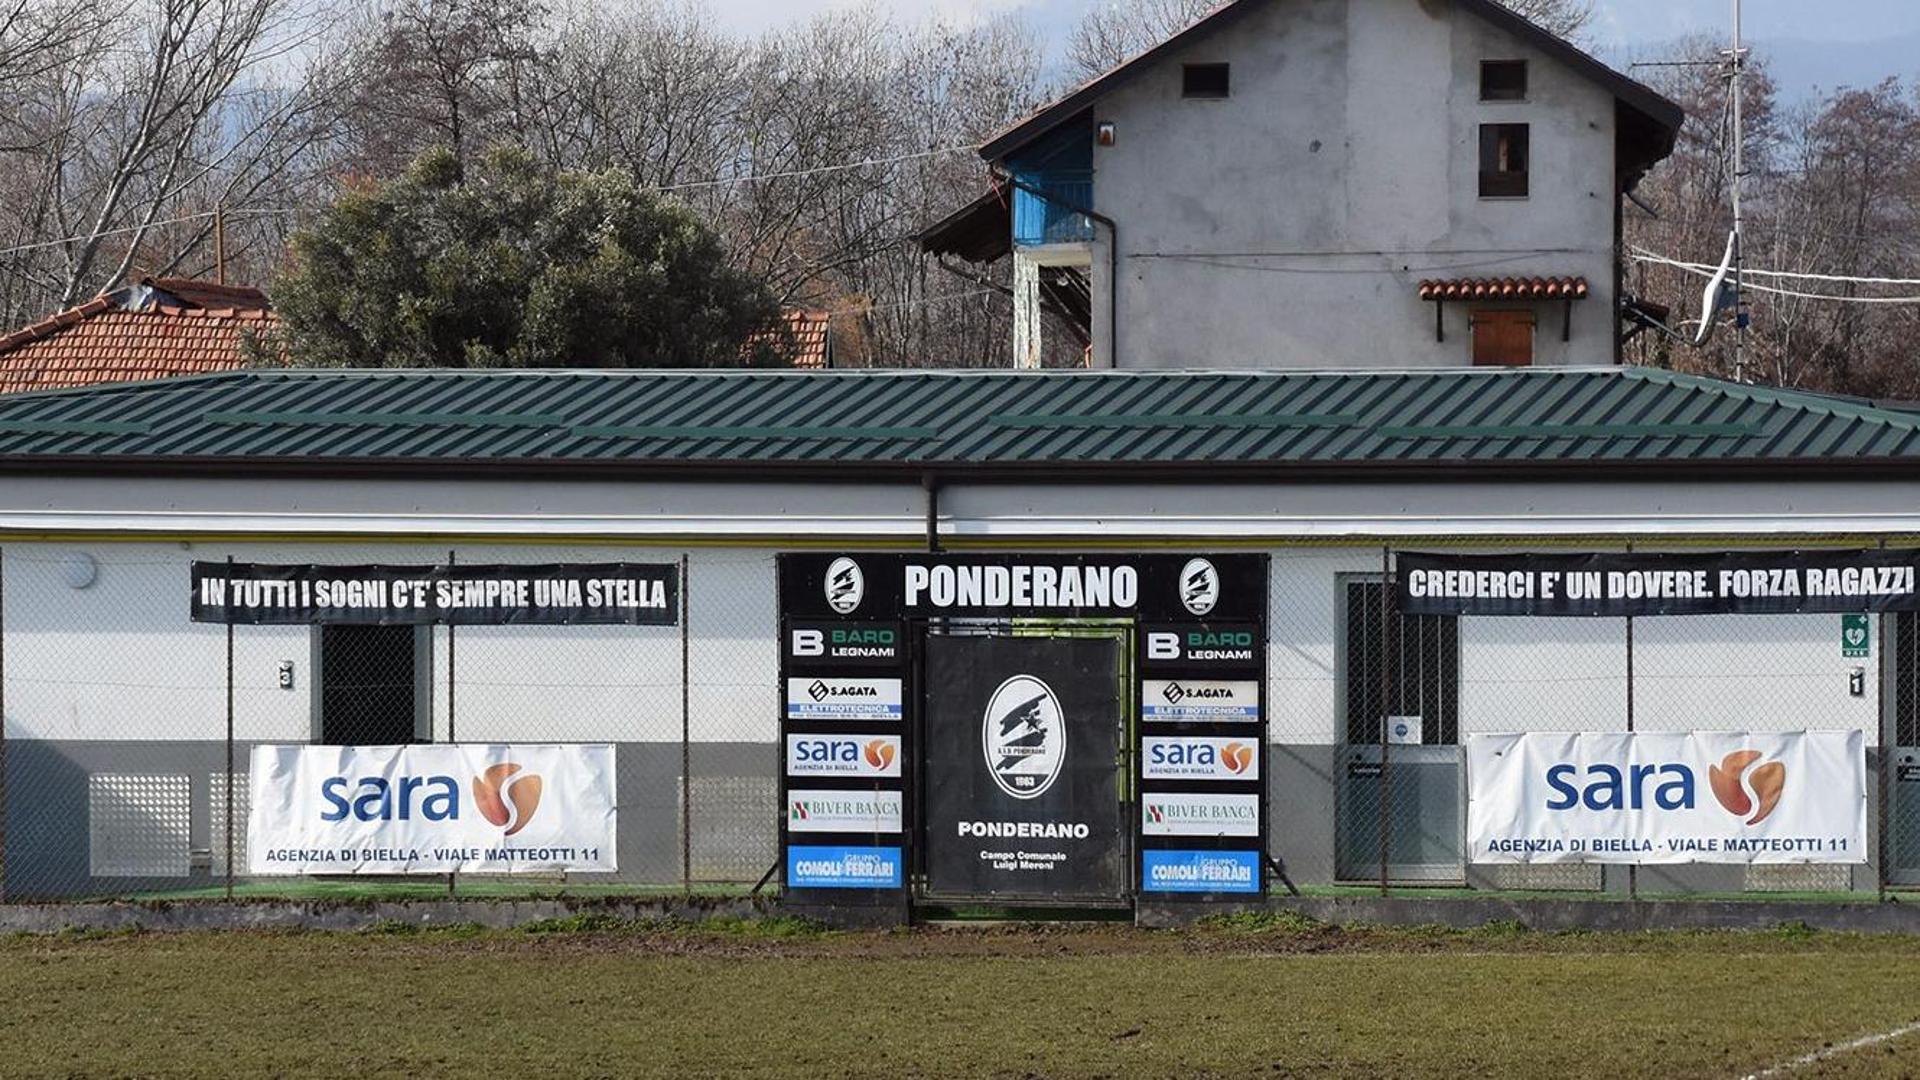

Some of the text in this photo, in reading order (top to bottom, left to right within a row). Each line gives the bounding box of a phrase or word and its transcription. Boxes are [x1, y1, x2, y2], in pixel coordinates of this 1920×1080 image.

[905, 565, 1138, 608] PONDERANO
[1409, 566, 1914, 599] CREDERCI E' UN DOVERE. FORZA RAGAZZI
[201, 578, 667, 608] IN TUTTI I SOGNI C'E' SEMPRE UNA STELLA
[832, 630, 894, 643] BARO
[1188, 633, 1252, 646] BARO
[832, 647, 895, 657] LEGNAMI
[1188, 650, 1252, 659] LEGNAMI
[280, 671, 290, 685] 3
[831, 687, 877, 696] S.AGATA
[1852, 678, 1861, 693] 1
[1186, 689, 1233, 698] S.AGATA
[800, 704, 890, 713] ELETTROTECNICA
[1154, 706, 1247, 715] ELETTROTECNICA
[796, 740, 858, 762] sara
[1151, 743, 1215, 765] sara
[1545, 763, 1695, 811] sara
[320, 775, 460, 821] sara
[813, 801, 900, 815] BIVER BANCA
[1168, 804, 1256, 819] BIVER BANCA
[958, 822, 1089, 839] PONDERANO
[1488, 838, 1563, 852] AGENZIA
[1569, 839, 1586, 851] DI
[1592, 838, 1652, 852] BIELLA
[1668, 838, 1718, 851] VIALE
[1723, 838, 1822, 851] MATTEOTTI
[1828, 838, 1848, 851] 11
[266, 849, 335, 862] AGENZIA
[341, 849, 357, 861] DI
[362, 849, 419, 861] BIELLA
[434, 848, 479, 861] VIALE
[484, 848, 576, 861] MATTEOTTI
[581, 848, 599, 861] 11
[845, 854, 880, 863] GRUPPO
[980, 851, 1066, 862] Campo Comunale
[1203, 858, 1238, 866] GRUPPO
[796, 861, 894, 877] COMOLI FERRARI
[993, 861, 1054, 871] Luigi Meroni
[1151, 865, 1251, 881] COMOLI FERRARI
